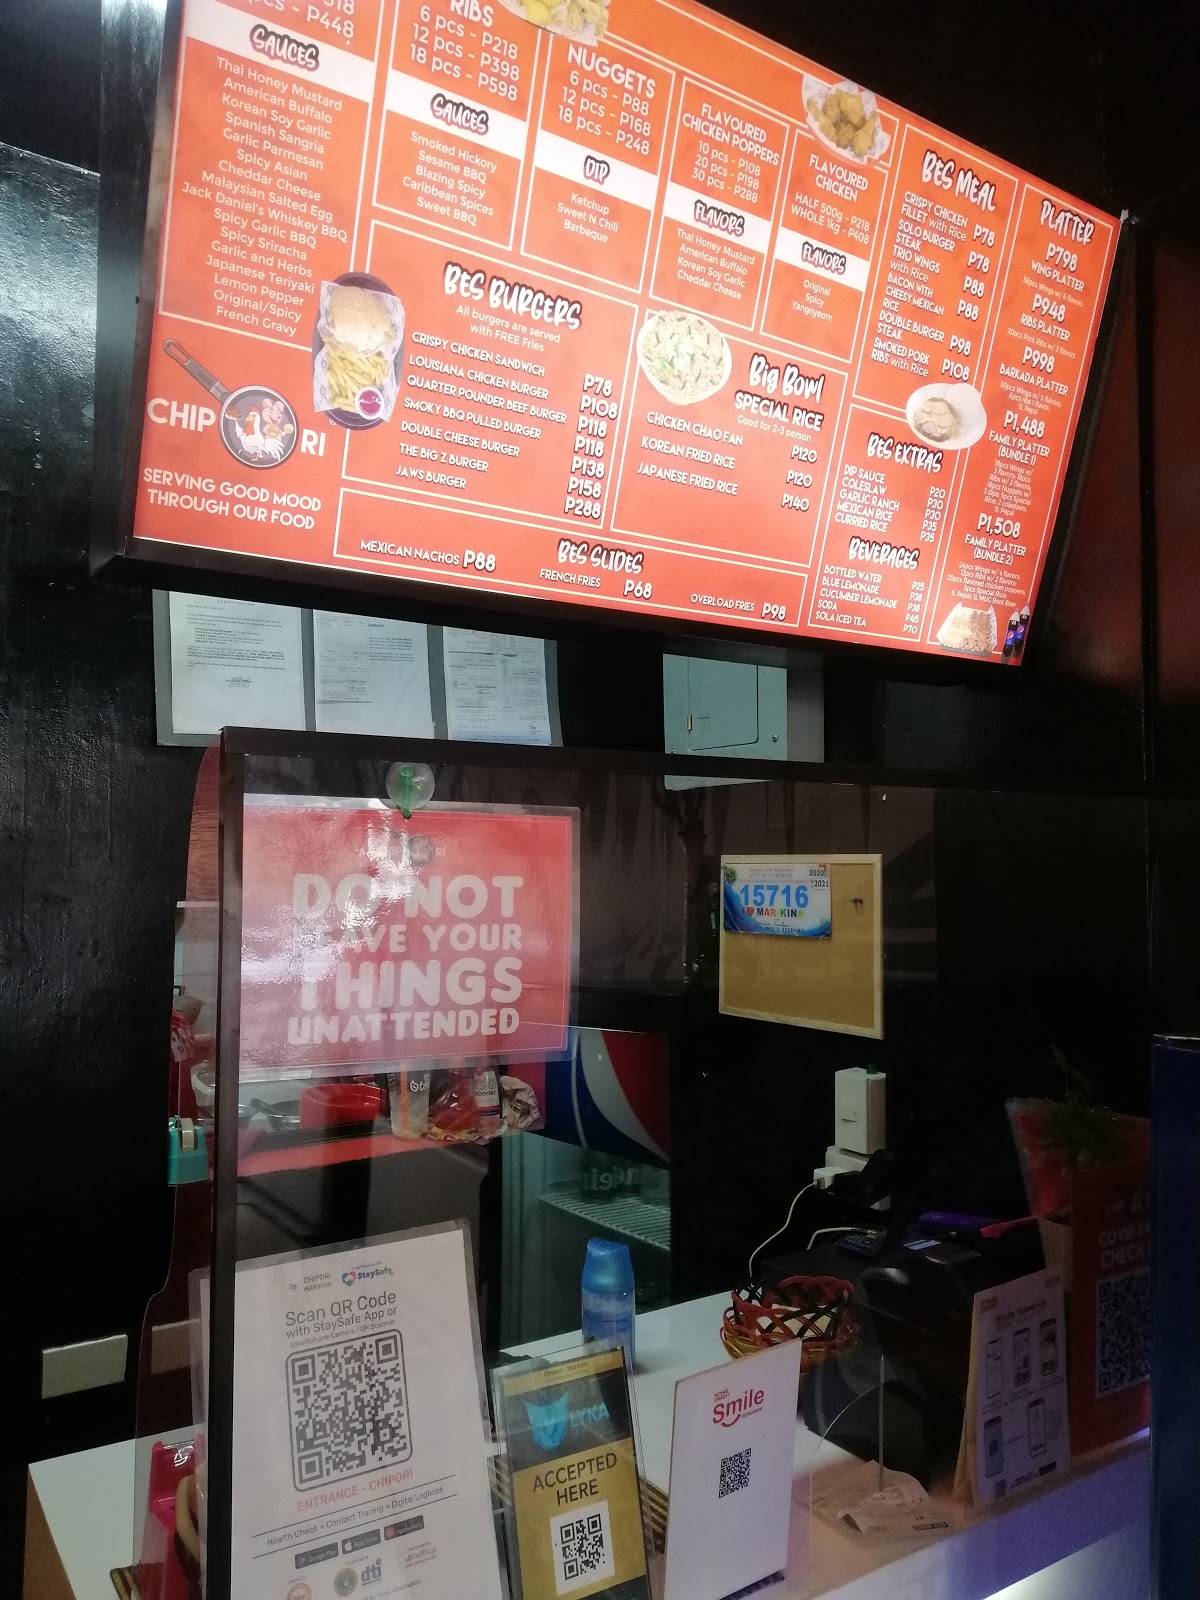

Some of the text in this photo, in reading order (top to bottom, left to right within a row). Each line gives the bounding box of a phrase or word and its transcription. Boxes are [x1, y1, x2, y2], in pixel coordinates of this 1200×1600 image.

[307, 5, 355, 38] P448
[450, 0, 494, 27] RIBS
[252, 26, 318, 70] SAUCES
[420, 5, 518, 59] 6 pcs P218
[413, 23, 519, 81] 12 pcs P398
[217, 56, 342, 110] Thai Honey Mustard
[410, 44, 517, 101] 18 pcs P598
[567, 44, 656, 98] NUGGETS
[223, 93, 330, 139] Korean Soy Garlic
[224, 78, 332, 123] American Buffalo
[432, 95, 487, 133] SAUCES
[224, 128, 323, 169] Garlic Parmesan
[225, 112, 324, 154] Spanish Sangria
[237, 149, 307, 180] Spicy Asian
[411, 131, 497, 172] Smoked Hickory
[419, 150, 486, 184] Sesame BBQ
[585, 158, 609, 183] DIP
[955, 170, 997, 212] MEAL
[182, 183, 347, 242] Jack Daniel's Whiskey BBQ
[695, 201, 745, 236] FLAVORS
[1041, 200, 1095, 246] PLATTER
[899, 219, 955, 252] SOLO BURGER
[973, 224, 995, 246] P78
[803, 243, 846, 273] FLAVORS
[1046, 243, 1077, 271] P798
[964, 276, 984, 297] P88
[488, 277, 582, 330] BURGERS
[1032, 294, 1065, 321] P948
[412, 332, 544, 376] CRISPY CHICKEN SANDWICH
[1023, 347, 1054, 372] P998
[410, 355, 548, 399] LOUISIANA CHICKEN BURGER
[584, 374, 612, 396] P78
[750, 354, 780, 396] Big
[407, 376, 567, 423] QUARTER POUNDER BEEF BURGER
[579, 397, 618, 421] P108
[735, 393, 825, 432] SPECIAL RICE
[405, 398, 541, 438] SMOKY BBQ PULLED BURGER
[576, 416, 607, 439] P118
[1004, 410, 1045, 437] P1,488
[401, 421, 520, 456] DOUBLE CHEESE BURGER
[575, 437, 604, 460] P118
[642, 436, 735, 469] KOREAN FRIED RICE
[400, 443, 488, 471] THE BIG Z BURGER
[572, 457, 604, 480] P138
[895, 444, 943, 473] EXTRAS
[144, 468, 321, 511] SERVING GOOD MOOD
[396, 466, 466, 488] JAWS BURGER
[568, 477, 601, 501] P158
[785, 470, 812, 487] P120
[844, 464, 885, 484] DIP SAUCE
[148, 489, 314, 529] THROUGH OUR FOOD
[565, 498, 604, 518] P288
[930, 487, 945, 499] P20
[978, 513, 1020, 538] P1,508
[361, 540, 459, 565] MEXICAN NACHOS
[464, 550, 495, 571] P88
[591, 546, 643, 575] SLIDES
[849, 536, 920, 570] BEVERAGES
[540, 568, 600, 587] FRENCH FRIES
[624, 579, 652, 599] P68
[691, 594, 755, 611] OVERLOAD FRIES
[762, 603, 786, 620] P98
[293, 873, 524, 919] DO NOT
[740, 883, 809, 909] 15716
[423, 923, 523, 951] YOUR
[287, 1008, 520, 1044] UNATTENDED
[286, 1291, 396, 1326] Scan QR Code
[286, 1306, 397, 1339] with StaySafe App or
[712, 1388, 764, 1425] Smile
[532, 1452, 617, 1493] ACCEPTED
[296, 1468, 415, 1513] ENTRANCE CHIPORI
[556, 1479, 599, 1506] HERE
[267, 1486, 444, 1546] Health Check Contact Tracing Digital Logbook
